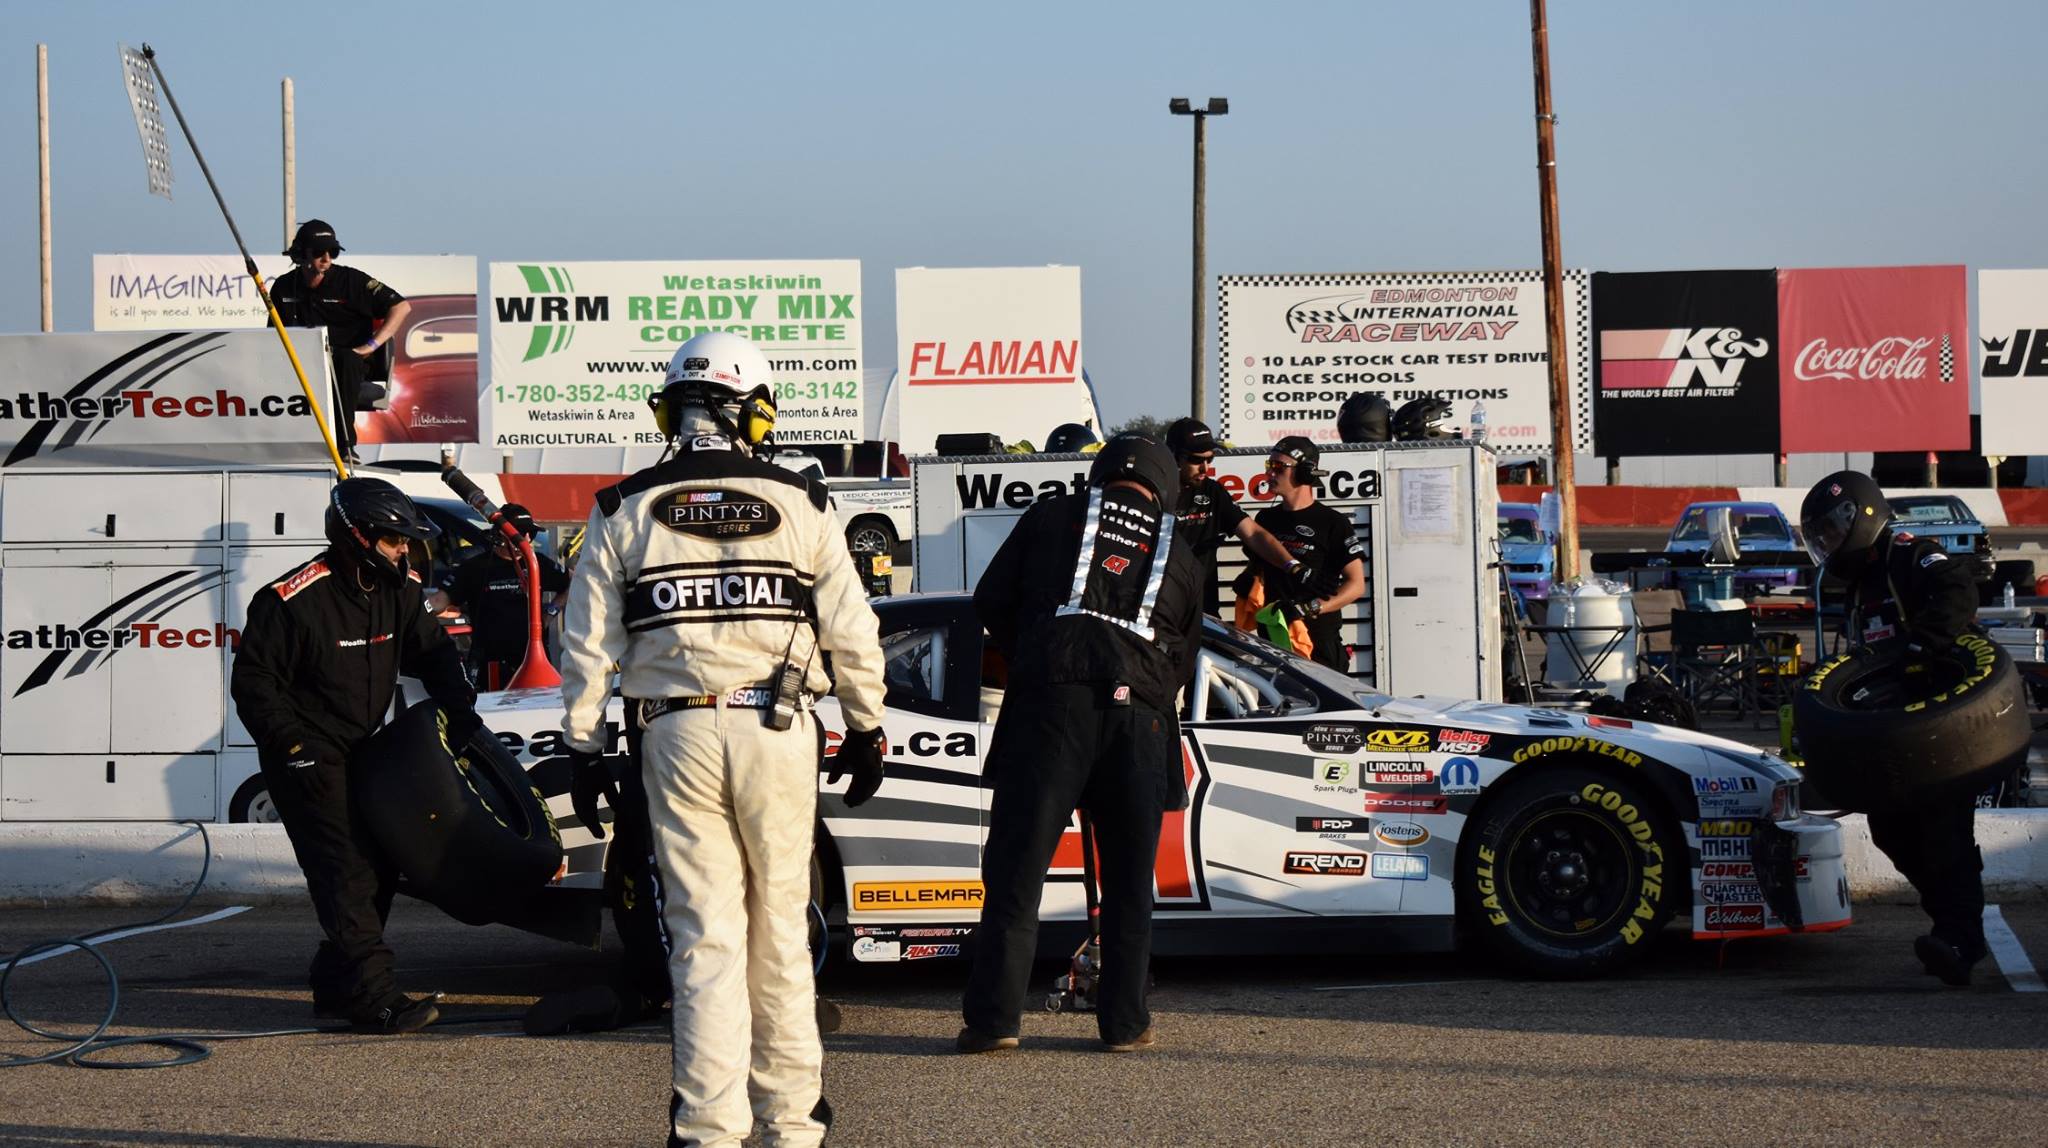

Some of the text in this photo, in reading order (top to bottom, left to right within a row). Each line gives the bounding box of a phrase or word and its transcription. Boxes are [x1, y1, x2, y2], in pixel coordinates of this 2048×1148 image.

[663, 275, 821, 291] Wetaskiwin
[1370, 287, 1518, 303] EDMONTON
[110, 306, 118, 317] is
[124, 306, 136, 317] all
[199, 305, 216, 316] We
[222, 305, 246, 317] have
[495, 296, 609, 323] WRM
[628, 295, 855, 321] READY MIX
[1353, 305, 1519, 319] INTERNATIONAL
[1301, 321, 1519, 343] RACEWAY
[909, 340, 1079, 376] FLAMAN
[1263, 356, 1284, 367] 10
[1290, 356, 1326, 367] LAP
[1332, 355, 1394, 366] STOCK
[1401, 354, 1439, 365] CAR
[1446, 353, 1488, 364] TEST
[1794, 336, 1934, 381] Coca-Cola
[1262, 372, 1415, 385] RACE SCHOOLS
[1393, 388, 1508, 401] FUNCTIONS
[1601, 388, 1734, 398] THE WORLD'S BEST AIR FILTER
[528, 406, 858, 422] Wetaskiwin & Area monton & Area
[497, 433, 616, 446] AGRICULTURAL
[690, 492, 723, 502] NASCAR
[674, 505, 762, 521] PINTY'S
[716, 523, 751, 534] SERIES
[652, 575, 792, 610] OFFICIAL
[1805, 655, 1851, 690] EAGLE
[726, 689, 771, 706] ASCAR
[1306, 733, 1361, 744] PINTY'S
[1438, 729, 1490, 744] Holley
[1437, 742, 1482, 753] MSD
[1369, 762, 1422, 772] LINCOLN
[1381, 773, 1427, 782] WELDERS
[1695, 777, 1738, 792] Mobil
[1337, 785, 1358, 794] Plugs
[1322, 820, 1352, 829] FDP
[1380, 823, 1421, 836] jostens
[1289, 855, 1364, 872] TREND
[1477, 845, 1510, 926] EAGLE
[1703, 884, 1759, 897] QUARTER
[1713, 893, 1761, 902] MASTER
[907, 945, 960, 959] AMSOIL
